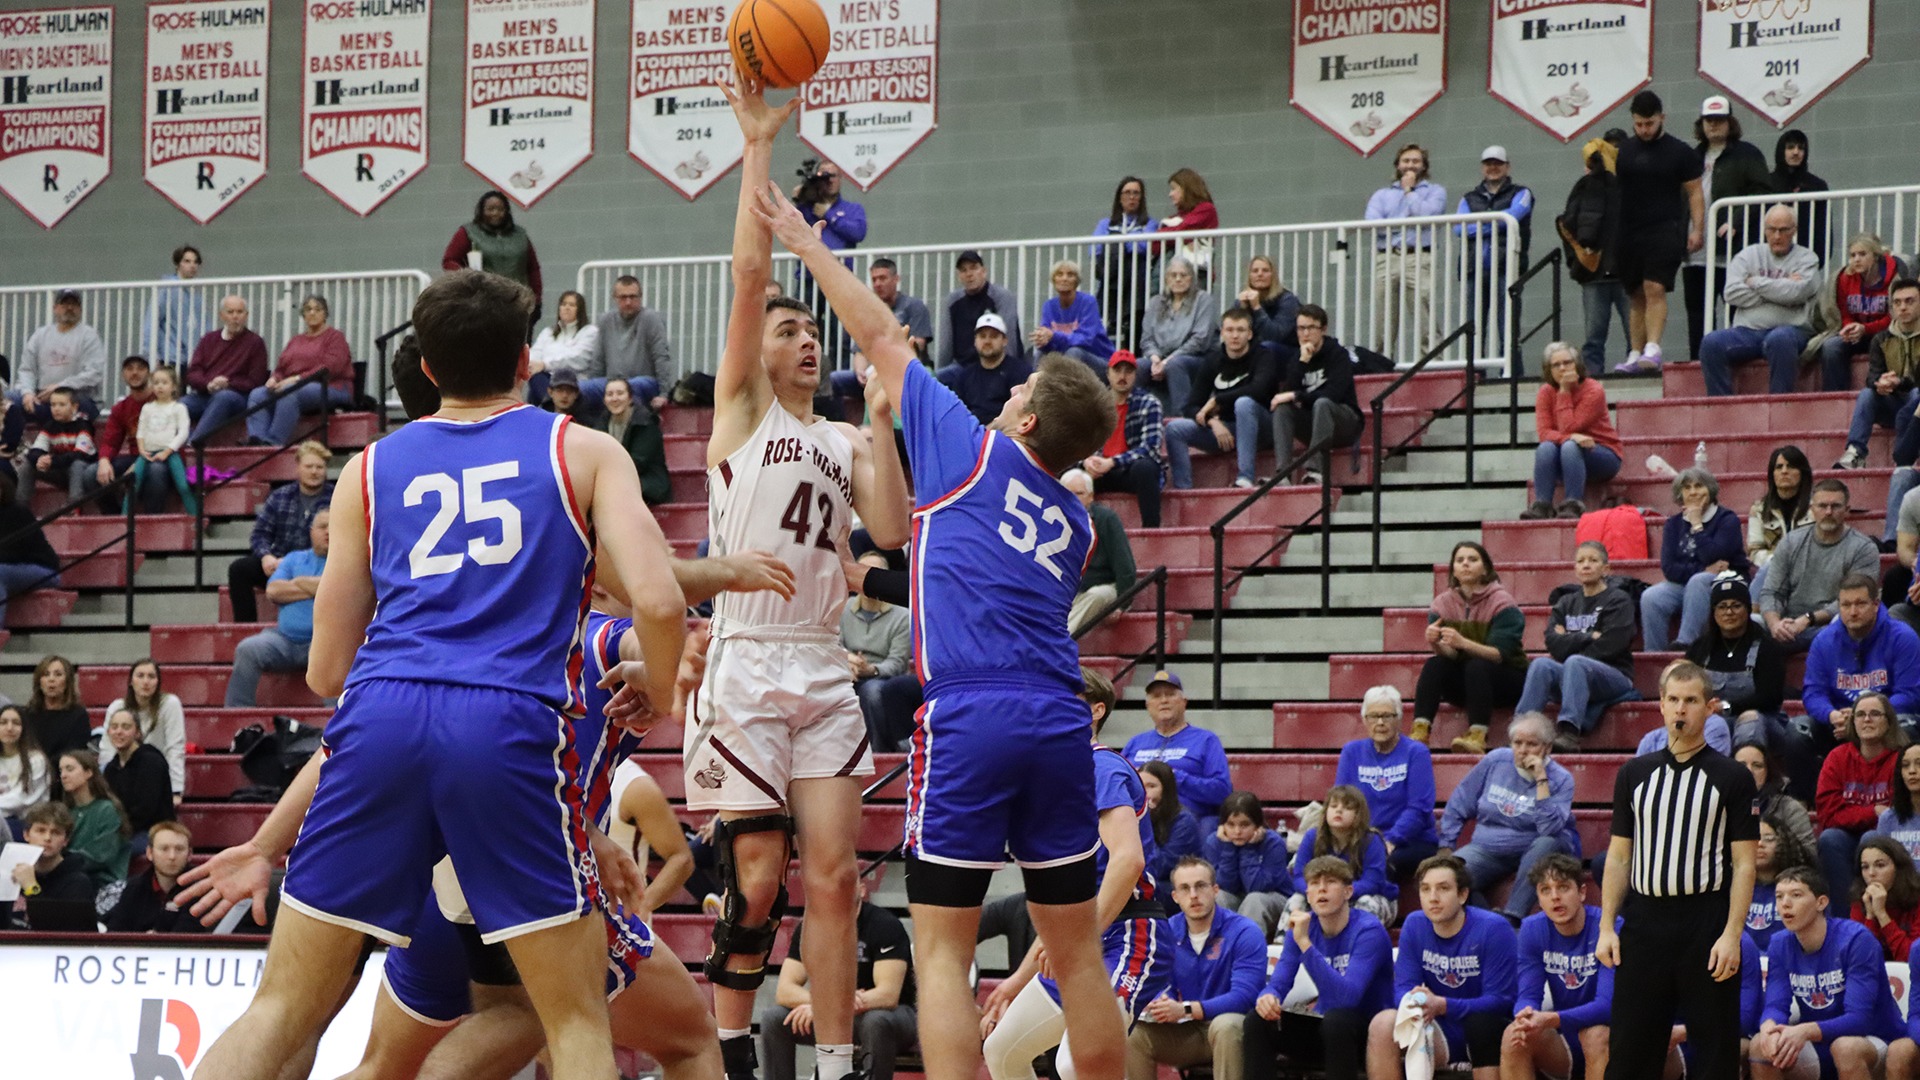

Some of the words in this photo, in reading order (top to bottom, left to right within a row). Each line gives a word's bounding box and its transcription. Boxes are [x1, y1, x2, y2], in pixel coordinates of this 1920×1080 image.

[152, 7, 265, 33] ROSE-HULMAN
[310, 0, 425, 22] ROSE-HULMAN
[668, 6, 726, 26] MEN'S
[840, 0, 900, 24] MEN'S
[1301, 4, 1438, 39] CHAMPIONS
[0, 12, 109, 38] ROSE-HULMAN
[503, 18, 558, 38] MEN'S
[636, 26, 728, 48] BASKETB
[1520, 15, 1627, 41] Heartland
[1728, 18, 1841, 49] Heartland
[340, 31, 393, 51] MEN'S
[472, 36, 589, 60] BASKETBALL
[832, 24, 935, 52] SKETBALL
[0, 47, 33, 70] MEN'S
[37, 44, 108, 69] BASKETBALL
[181, 41, 233, 60] MEN'S
[310, 50, 423, 73] BASKETBALL
[637, 53, 733, 69] TOURNAME
[152, 61, 262, 82] BASKETBALL
[473, 64, 534, 80] REGULAR
[535, 61, 587, 76] SEASON
[873, 58, 928, 76] SEASON
[1319, 53, 1418, 81] Heartland
[1547, 61, 1590, 77] 2011
[1765, 58, 1800, 77] 2011
[2, 75, 103, 104] Heartland
[313, 78, 420, 106] Heartland
[472, 75, 588, 103] CHAMPIONS
[807, 74, 930, 106] CHAMPIONS
[1351, 91, 1385, 109] 2018
[155, 88, 259, 115] Heartland
[654, 97, 730, 116] Heartlan
[2, 109, 102, 126] TOURNAMENT
[153, 120, 260, 137] TOURNAMENT
[489, 106, 573, 127] Heartland
[824, 110, 912, 136] Heartland
[2, 124, 99, 153] CHAMPIONS
[311, 112, 421, 152] CHAMPIONS
[676, 127, 713, 141] 2014
[152, 133, 260, 161] CHAMPIONS
[510, 138, 546, 152] 2014
[854, 143, 877, 157] 2018
[63, 179, 89, 204] 2012
[219, 177, 246, 200] 2013
[378, 168, 406, 193] 2013
[403, 460, 523, 580] 25
[779, 480, 836, 553] 42
[998, 477, 1073, 582] 52
[1449, 955, 1479, 969] COLLEGE
